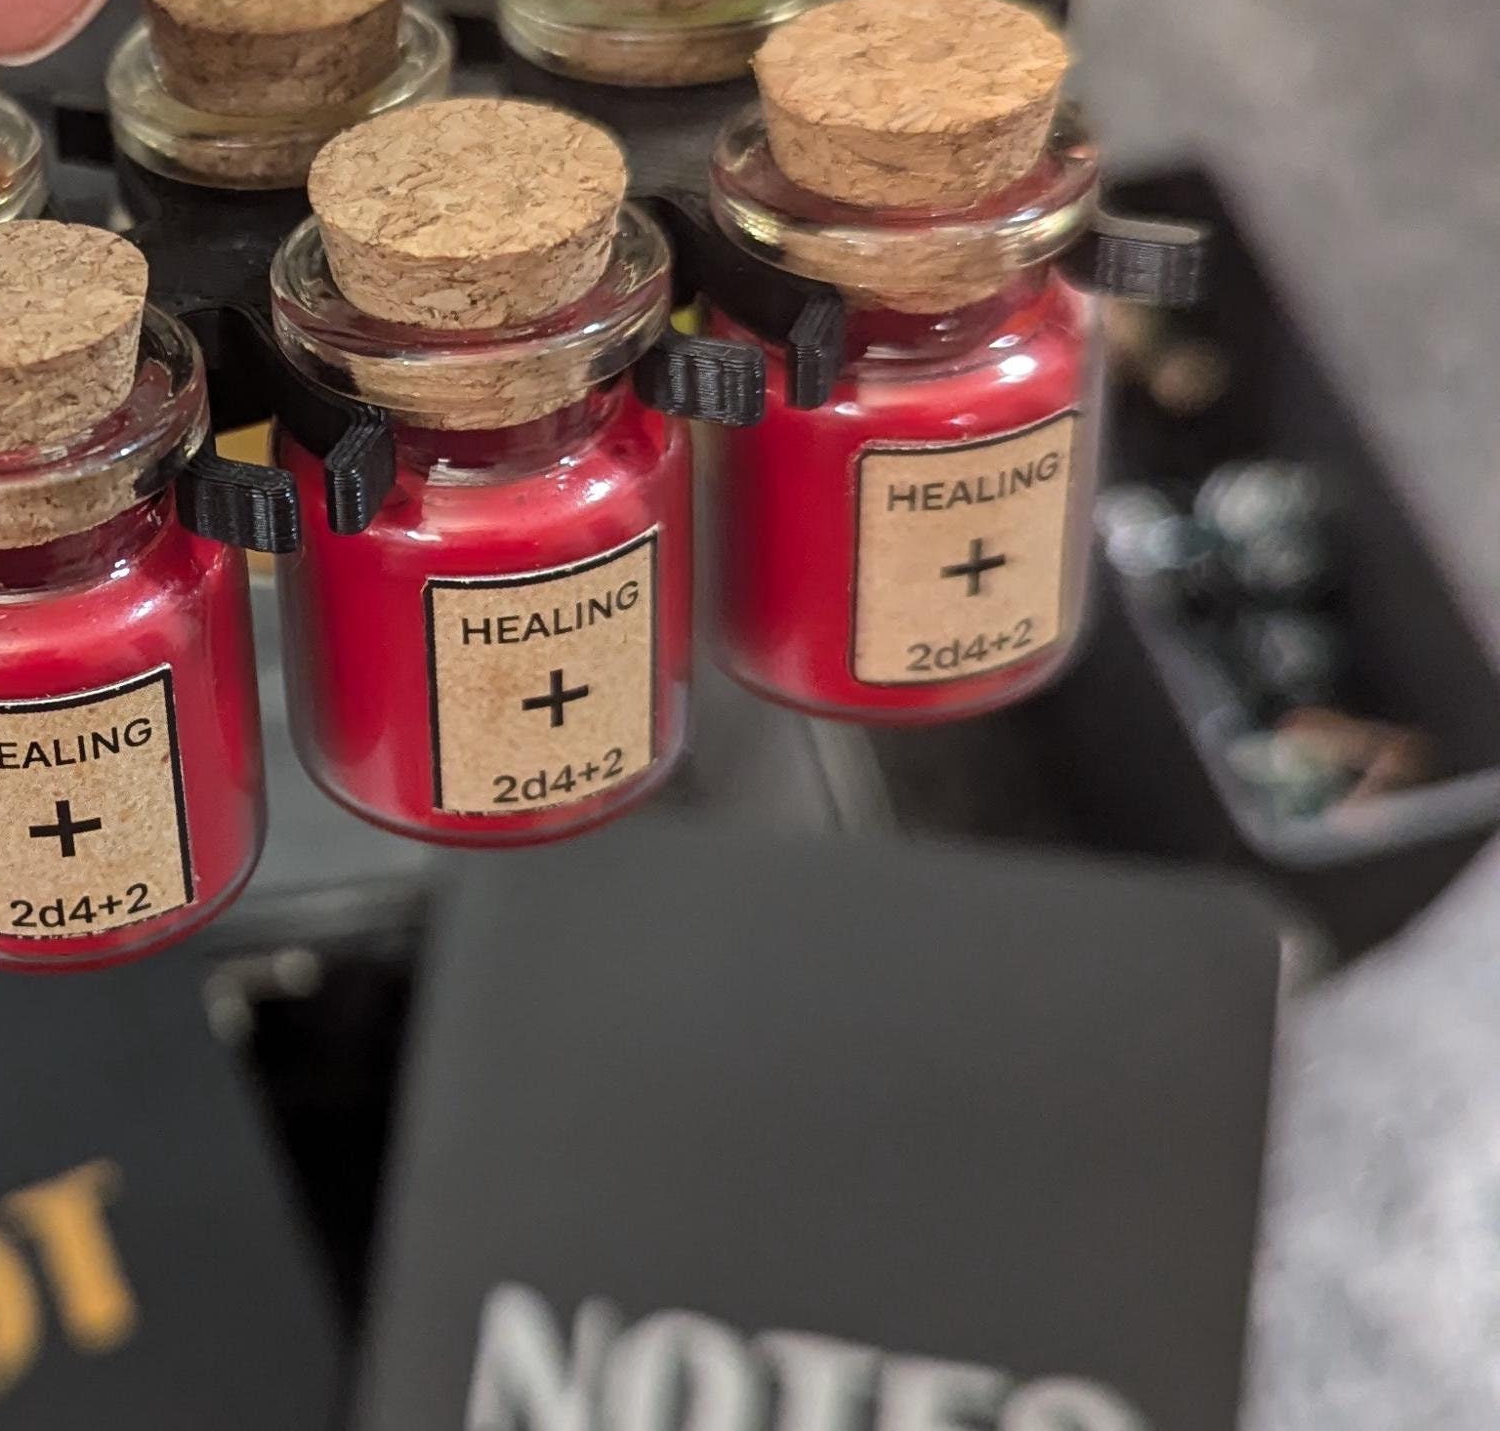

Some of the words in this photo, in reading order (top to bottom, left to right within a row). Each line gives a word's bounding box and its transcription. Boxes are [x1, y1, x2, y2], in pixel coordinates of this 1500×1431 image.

[887, 452, 1060, 512] HEALING
[461, 580, 639, 645] HEALING
[905, 618, 1034, 672] 2d4+2
[492, 748, 624, 804] 2d4+2
[9, 882, 152, 928] 2d4+2
[464, 1278, 1152, 1431] NOT
